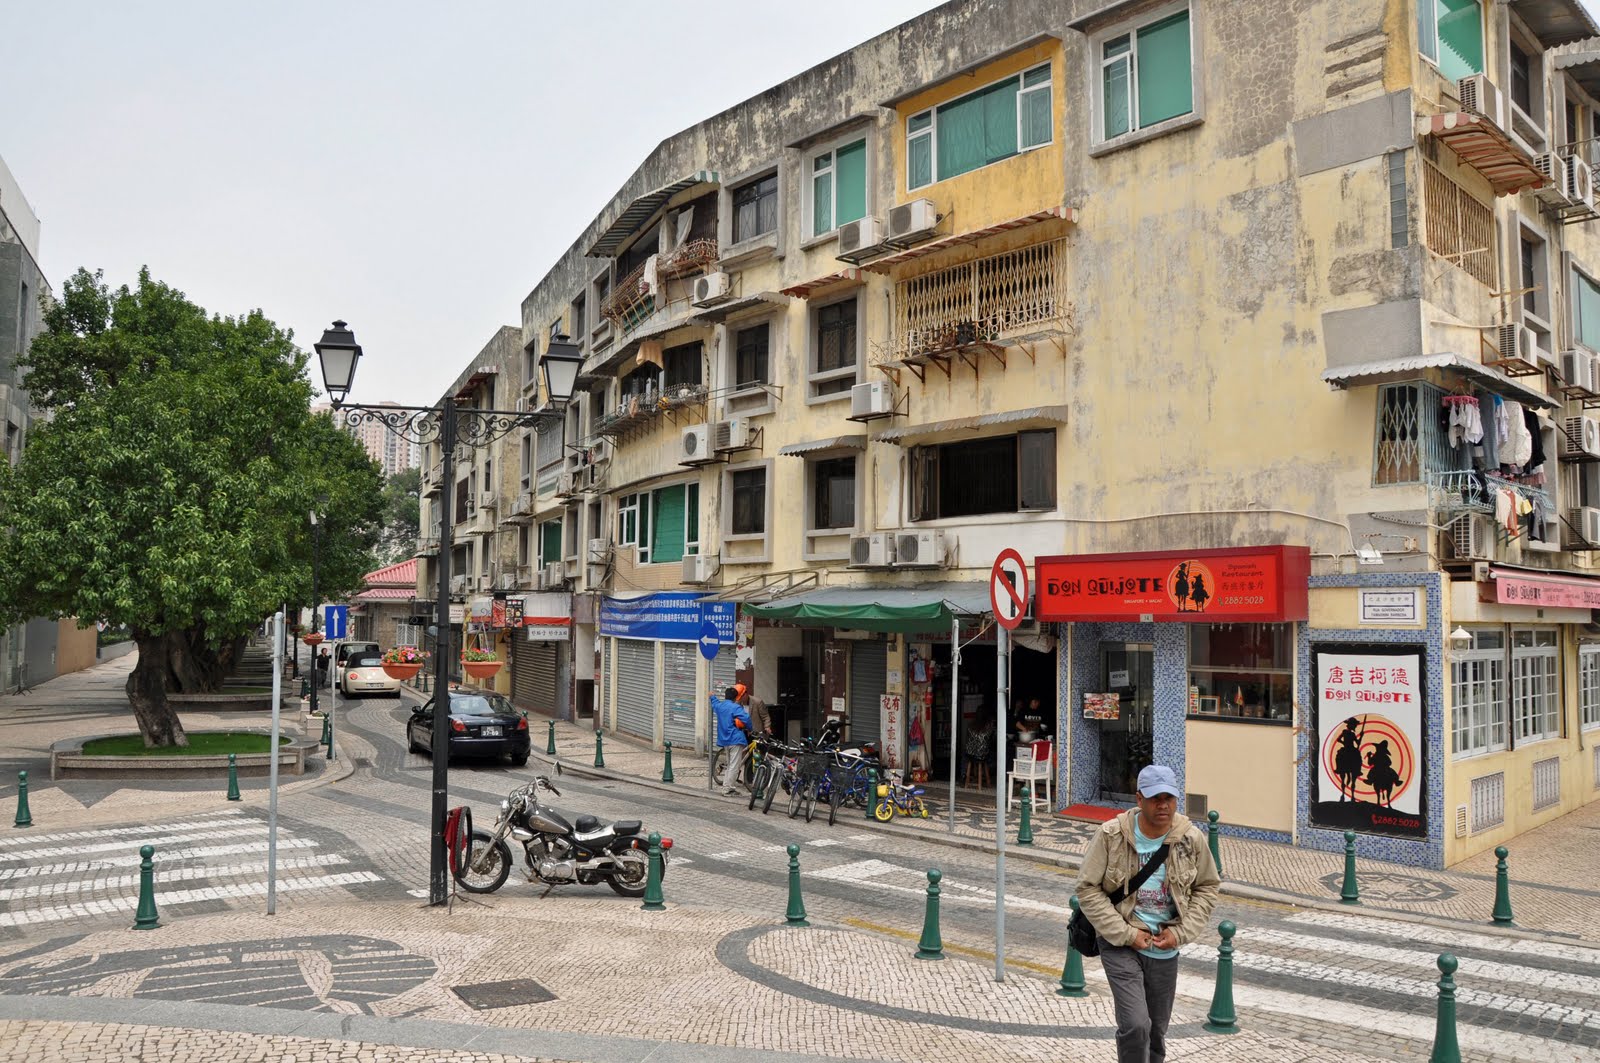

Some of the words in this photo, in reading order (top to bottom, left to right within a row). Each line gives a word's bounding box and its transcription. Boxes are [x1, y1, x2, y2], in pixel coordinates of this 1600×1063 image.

[1047, 578, 1081, 597] DON
[1087, 577, 1163, 596] QUIJOTE
[1327, 666, 1410, 686] 唐吉柯德
[1325, 687, 1351, 702] DON
[1355, 689, 1413, 704] QUIJOTE
